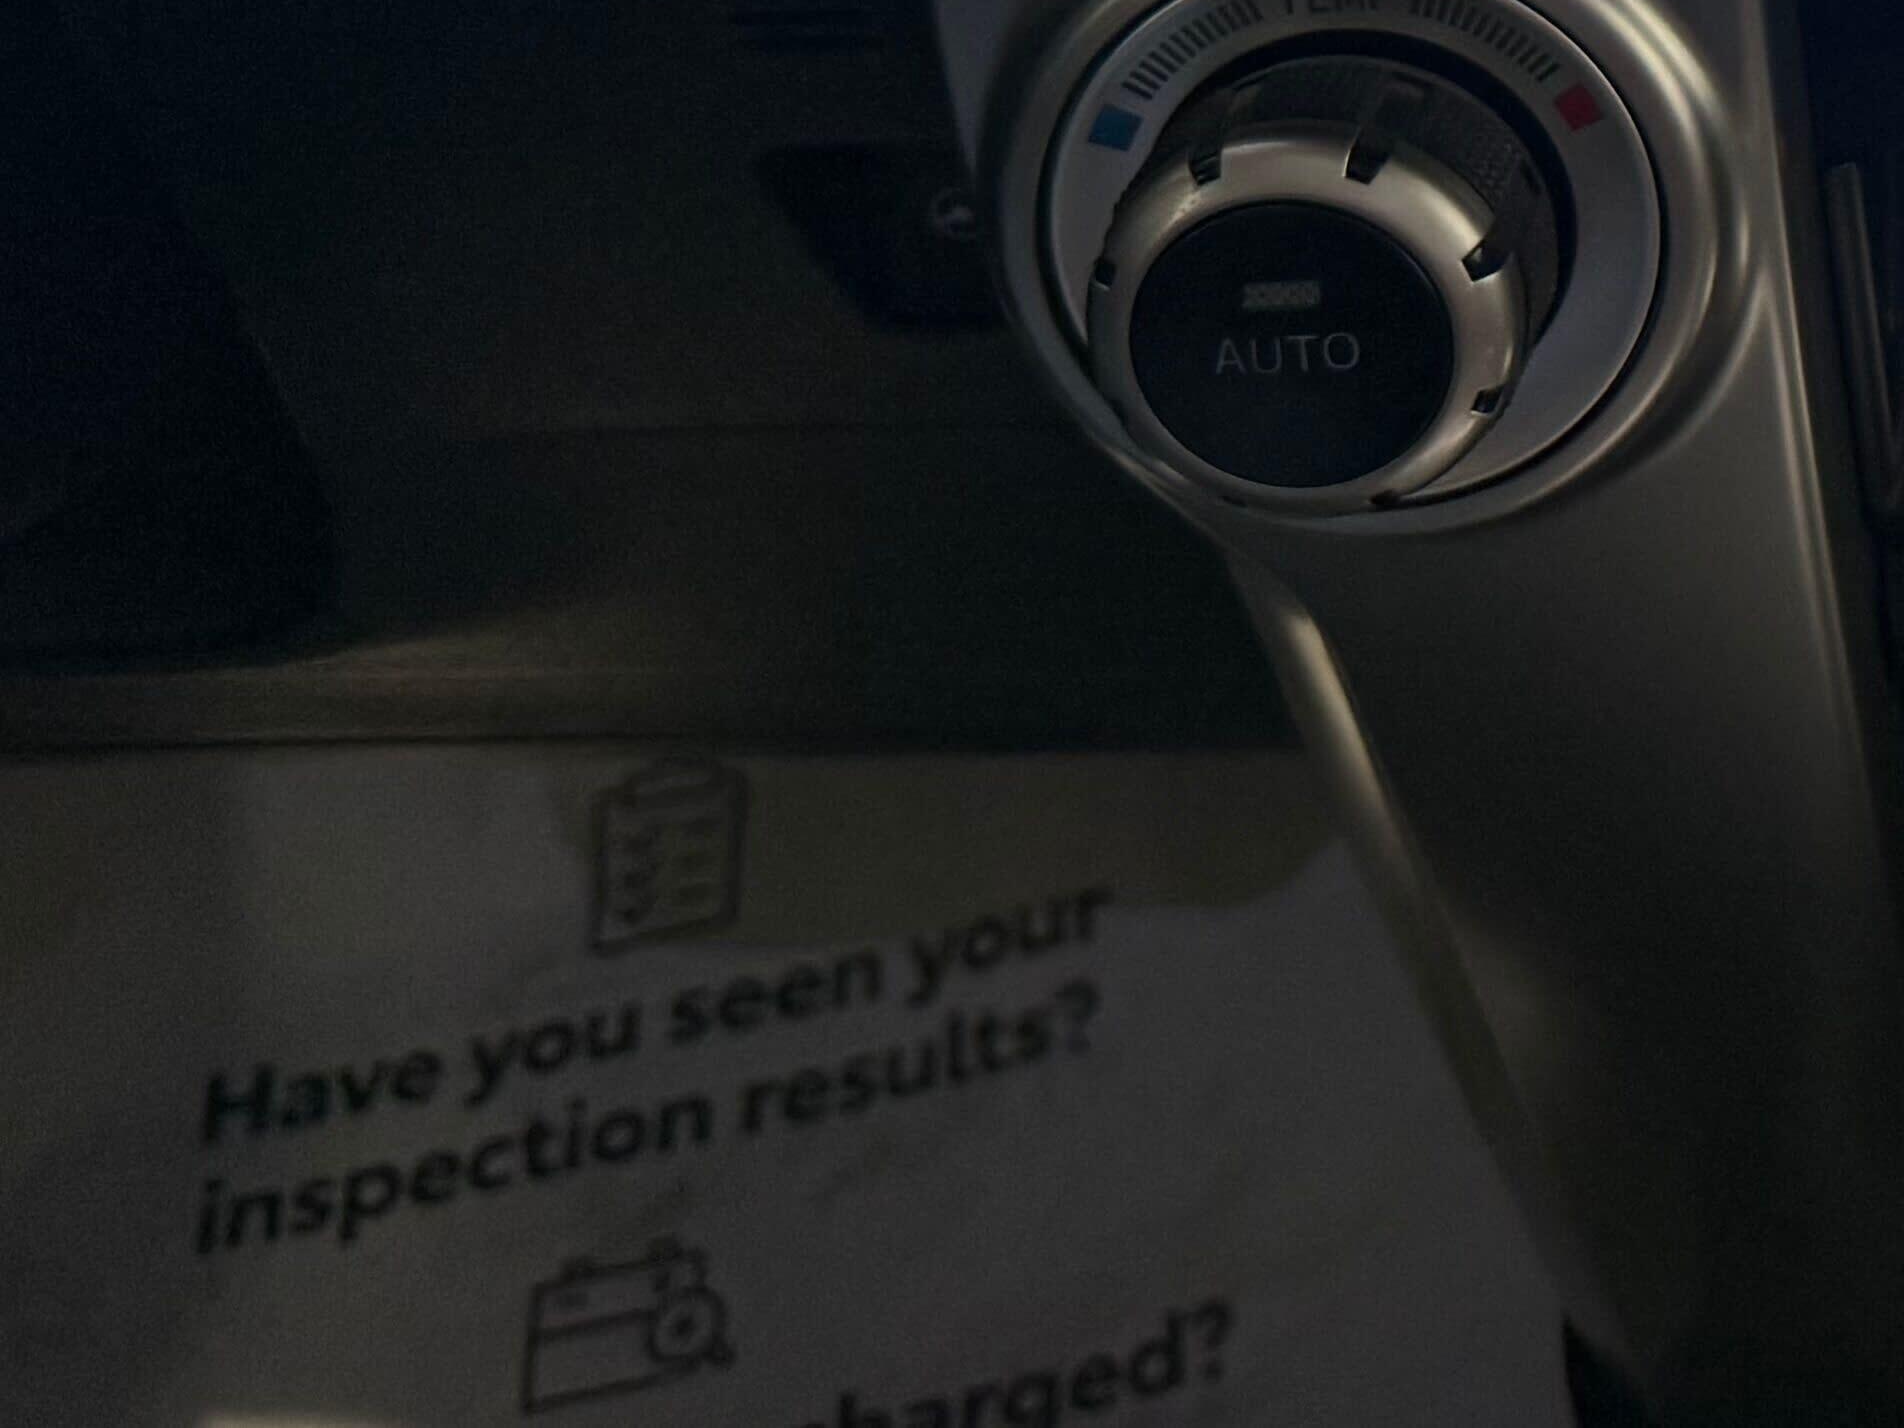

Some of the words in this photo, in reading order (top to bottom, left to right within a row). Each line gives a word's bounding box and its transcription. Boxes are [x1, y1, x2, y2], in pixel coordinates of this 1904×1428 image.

[1214, 331, 1362, 377] AUTO
[200, 1044, 444, 1146] Have
[464, 997, 643, 1109] you
[667, 950, 884, 1044] seen
[906, 883, 1113, 1007] your
[195, 1087, 715, 1256] inspection
[737, 978, 1100, 1136] results?
[800, 1297, 1236, 1428] harged?
